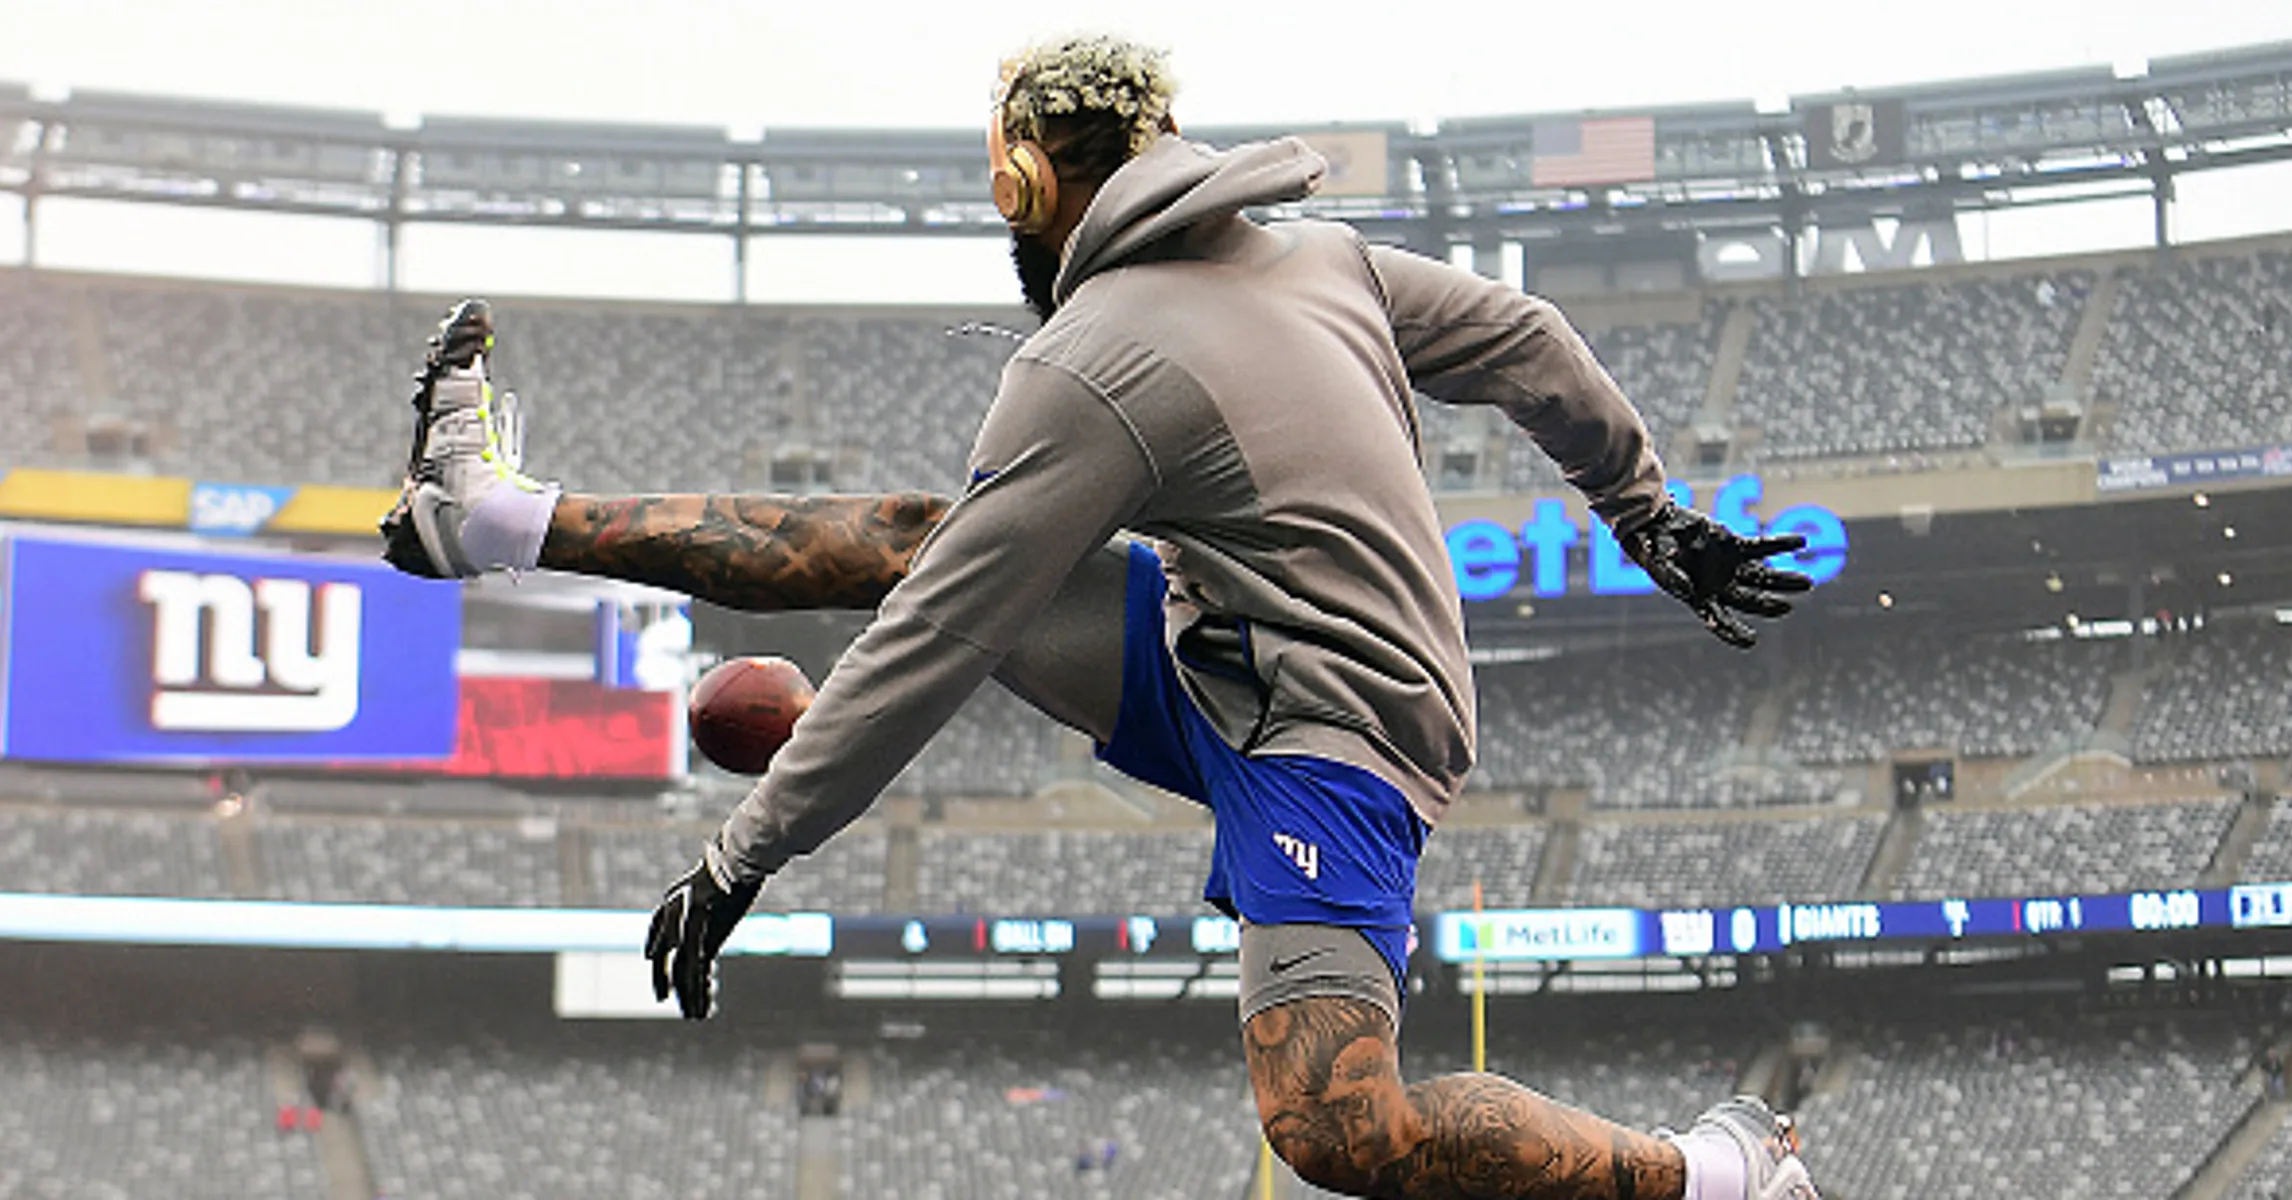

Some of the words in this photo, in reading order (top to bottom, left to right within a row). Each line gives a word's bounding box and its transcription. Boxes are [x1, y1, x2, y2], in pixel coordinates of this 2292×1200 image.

[193, 488, 275, 532] SAP
[1507, 920, 1618, 945] MetLife
[1794, 903, 1881, 938] GIANTS
